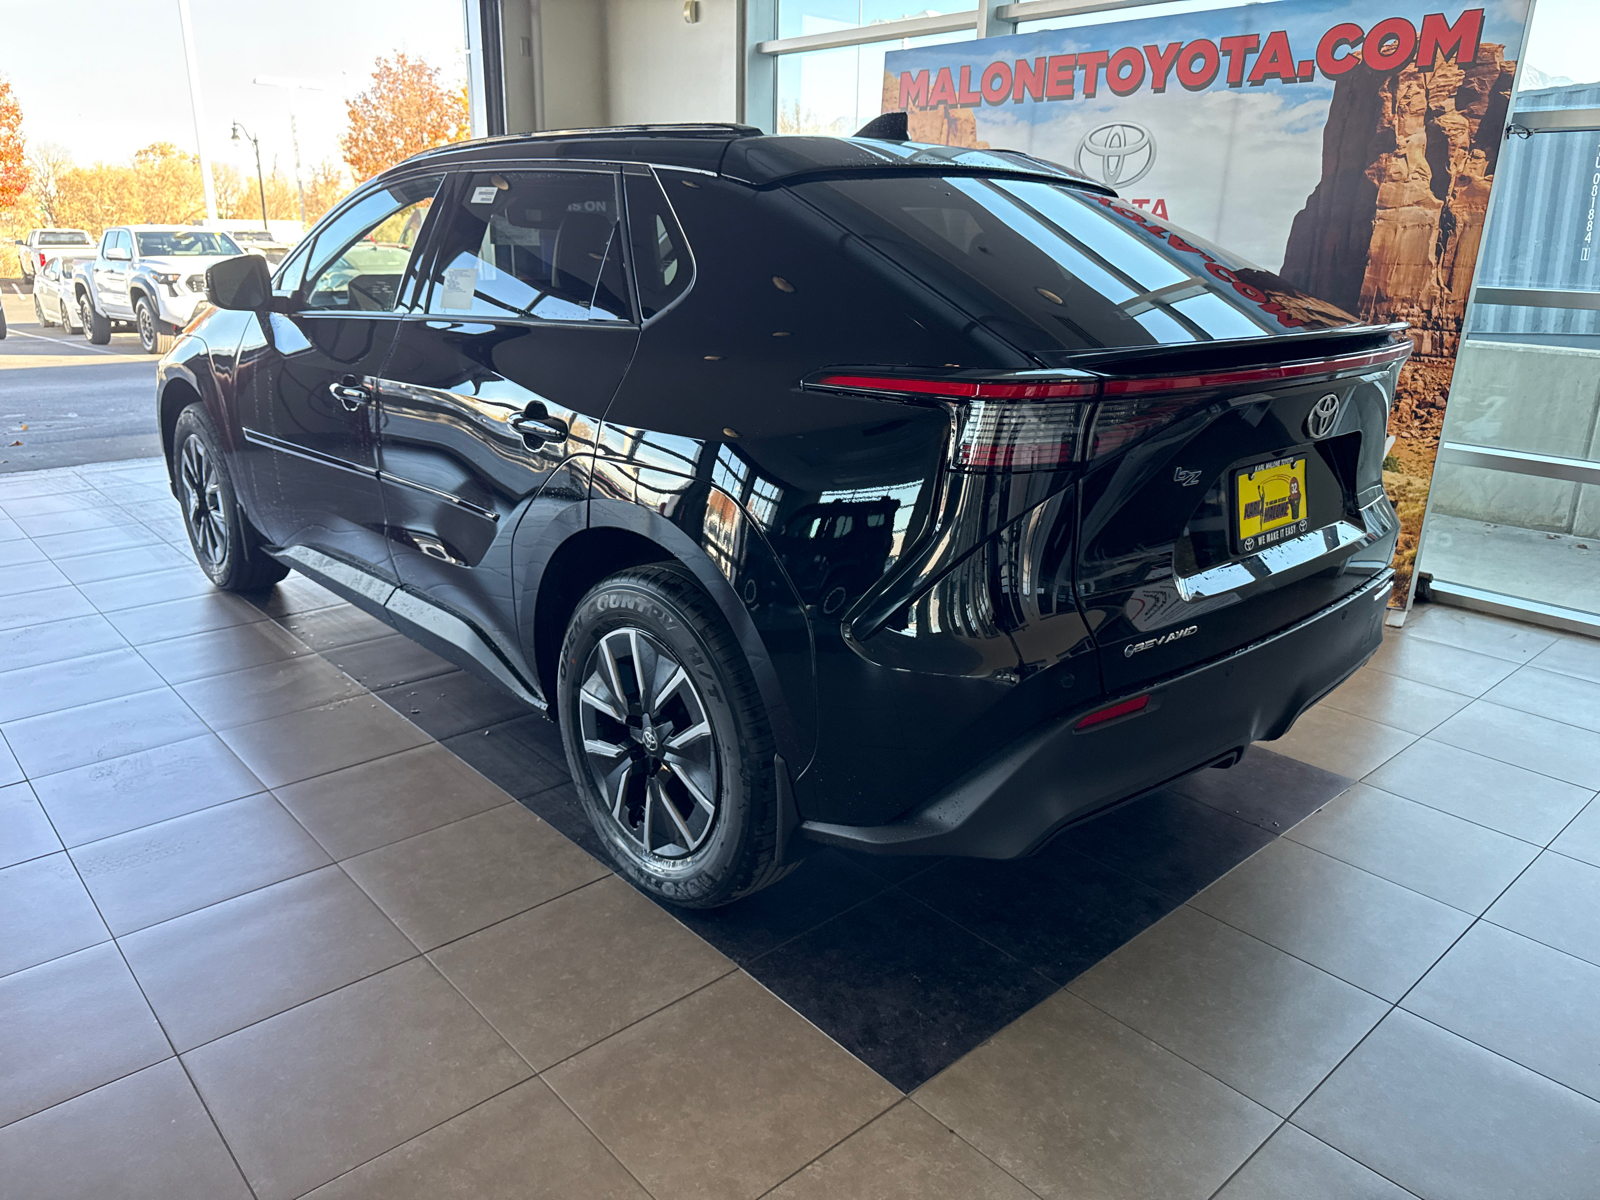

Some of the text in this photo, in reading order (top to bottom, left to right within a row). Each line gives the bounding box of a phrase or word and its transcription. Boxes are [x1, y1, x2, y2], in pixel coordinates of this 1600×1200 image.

[899, 8, 1485, 108] MALONETOYOTA.COM
[1290, 483, 1298, 494] 32
[1258, 536, 1266, 546] WE
[1266, 532, 1279, 543] MAKE
[1285, 524, 1297, 536] EASY
[558, 618, 583, 686] OPEN
[588, 594, 678, 631] COUNTRY
